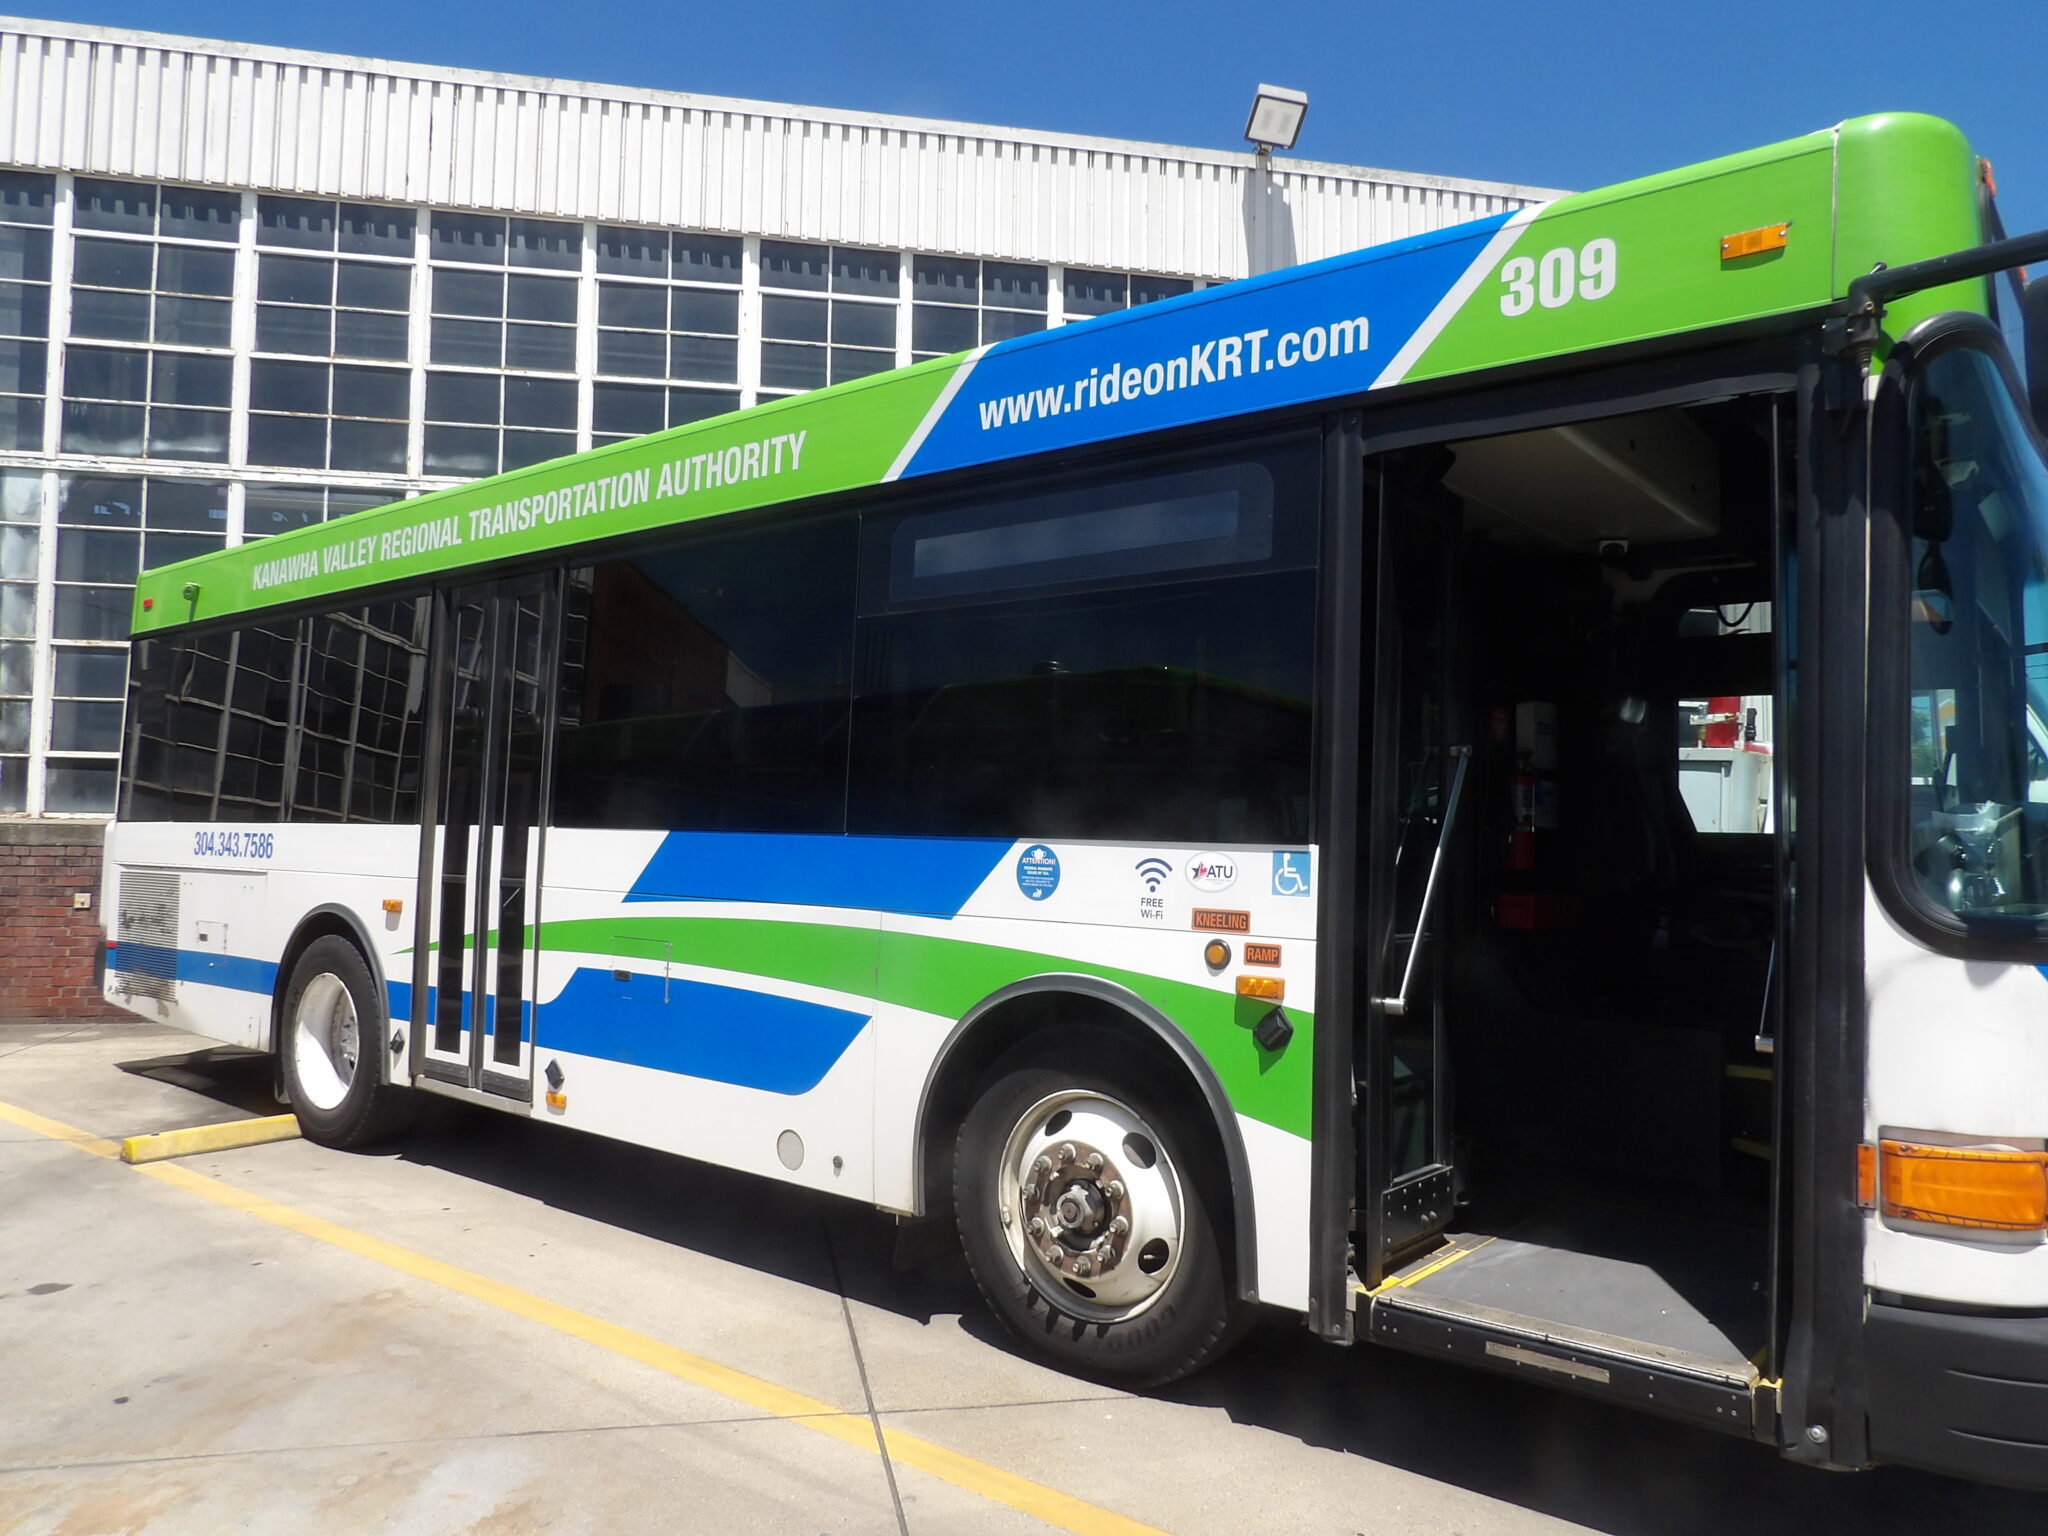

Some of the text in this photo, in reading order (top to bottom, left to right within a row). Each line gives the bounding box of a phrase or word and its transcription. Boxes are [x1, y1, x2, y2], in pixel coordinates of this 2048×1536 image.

[1500, 237, 1616, 317] 309
[979, 316, 1369, 430] www.rideonKRT.com
[253, 430, 807, 590] KANAWHA VALLEY REGIONAL TRANSPORTATION AUTHORITY
[193, 831, 274, 859] 304.343.7586
[1206, 864, 1233, 879] ATU
[1141, 897, 1163, 908] FREE
[1140, 909, 1163, 920] Wi-Fi
[1195, 913, 1247, 929] KNEELING
[1247, 948, 1279, 962] RAMP
